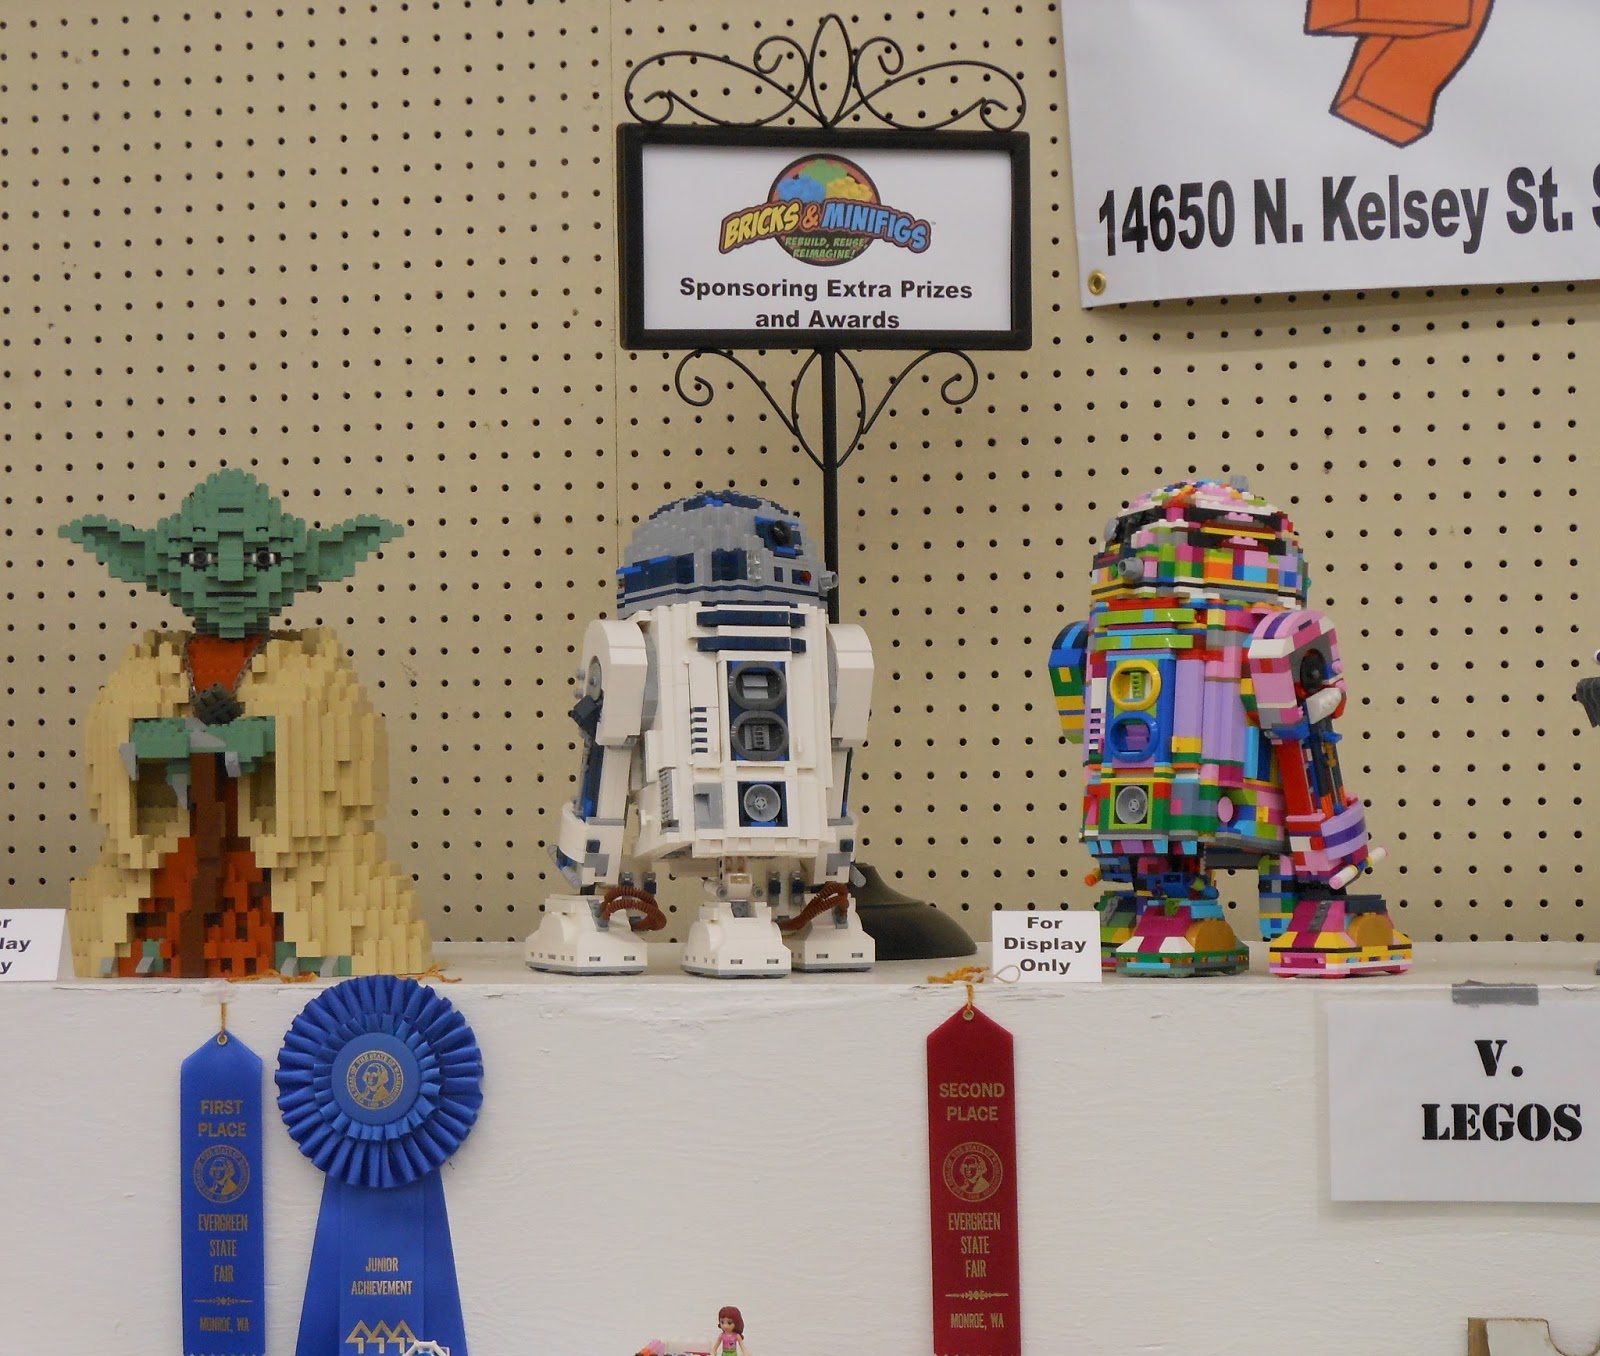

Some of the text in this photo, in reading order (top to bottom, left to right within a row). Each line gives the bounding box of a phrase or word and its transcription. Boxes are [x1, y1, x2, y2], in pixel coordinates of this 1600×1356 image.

[1098, 179, 1236, 257] 14650
[1253, 177, 1303, 246] N.
[1322, 174, 1490, 255] Kelsey
[1506, 165, 1573, 234] St.
[724, 202, 928, 250] BRICKS & MINIFIGS
[784, 236, 830, 249] REBUILD,
[793, 248, 856, 259] REIMAGINE!
[680, 277, 973, 302] Sponsoring Extra Prizes
[755, 310, 900, 328] and Awards
[1027, 917, 1063, 929] For
[1004, 937, 1087, 954] Display
[1020, 958, 1071, 975] Only
[1474, 1039, 1523, 1077] V.
[939, 1082, 1005, 1098] SECOND
[200, 1099, 243, 1115] FIRST
[947, 1105, 999, 1121] PLACE
[197, 1122, 247, 1137] PLACE
[1421, 1103, 1583, 1142] LEGOS
[198, 1213, 248, 1232] EVERGREEN
[947, 1212, 1001, 1231] EVERGREEN
[209, 1239, 237, 1257] STATE
[960, 1236, 991, 1254] STATE
[214, 1264, 234, 1282] FAIR
[365, 1257, 399, 1272] JUNIOR
[965, 1260, 987, 1278] FAIR
[351, 1280, 413, 1296] ACHIEVEMENT
[199, 1316, 250, 1334] MONROE, WA
[950, 1312, 1004, 1331] MONROE, WA
